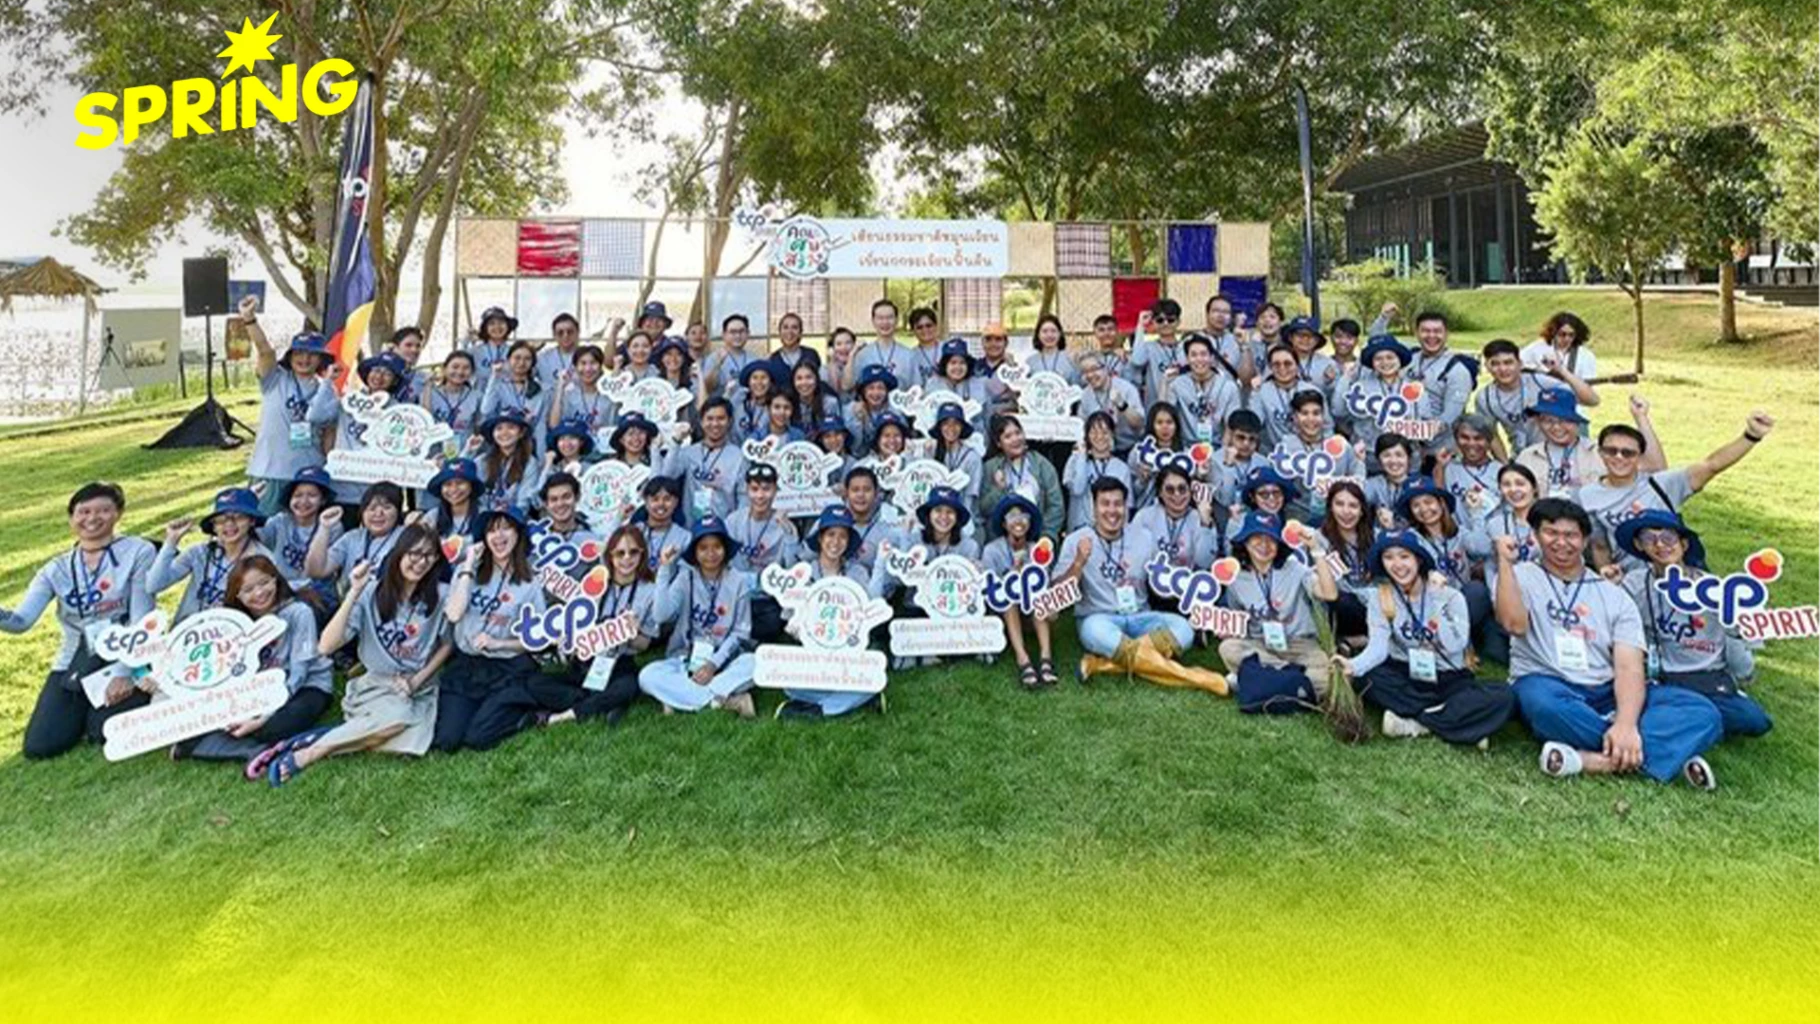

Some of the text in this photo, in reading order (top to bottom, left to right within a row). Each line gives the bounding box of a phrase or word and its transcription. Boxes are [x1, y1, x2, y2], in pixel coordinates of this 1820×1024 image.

[737, 210, 766, 231] tcp
[1346, 385, 1407, 426] tcp
[1270, 443, 1334, 486] tcp
[526, 519, 581, 599] tcp SPIRI
[889, 553, 917, 574] tcp
[767, 568, 797, 594] tcp
[981, 566, 1080, 617] tcp SPIRIT
[1148, 553, 1248, 637] tcp SPIRIT
[471, 588, 501, 615] tcp
[1657, 566, 1818, 639] tcp SPIRIT
[104, 630, 149, 654] tcp
[377, 624, 408, 650] tcp
[513, 597, 637, 658] tcp SPIRIT
[1657, 613, 1696, 642] tcp
